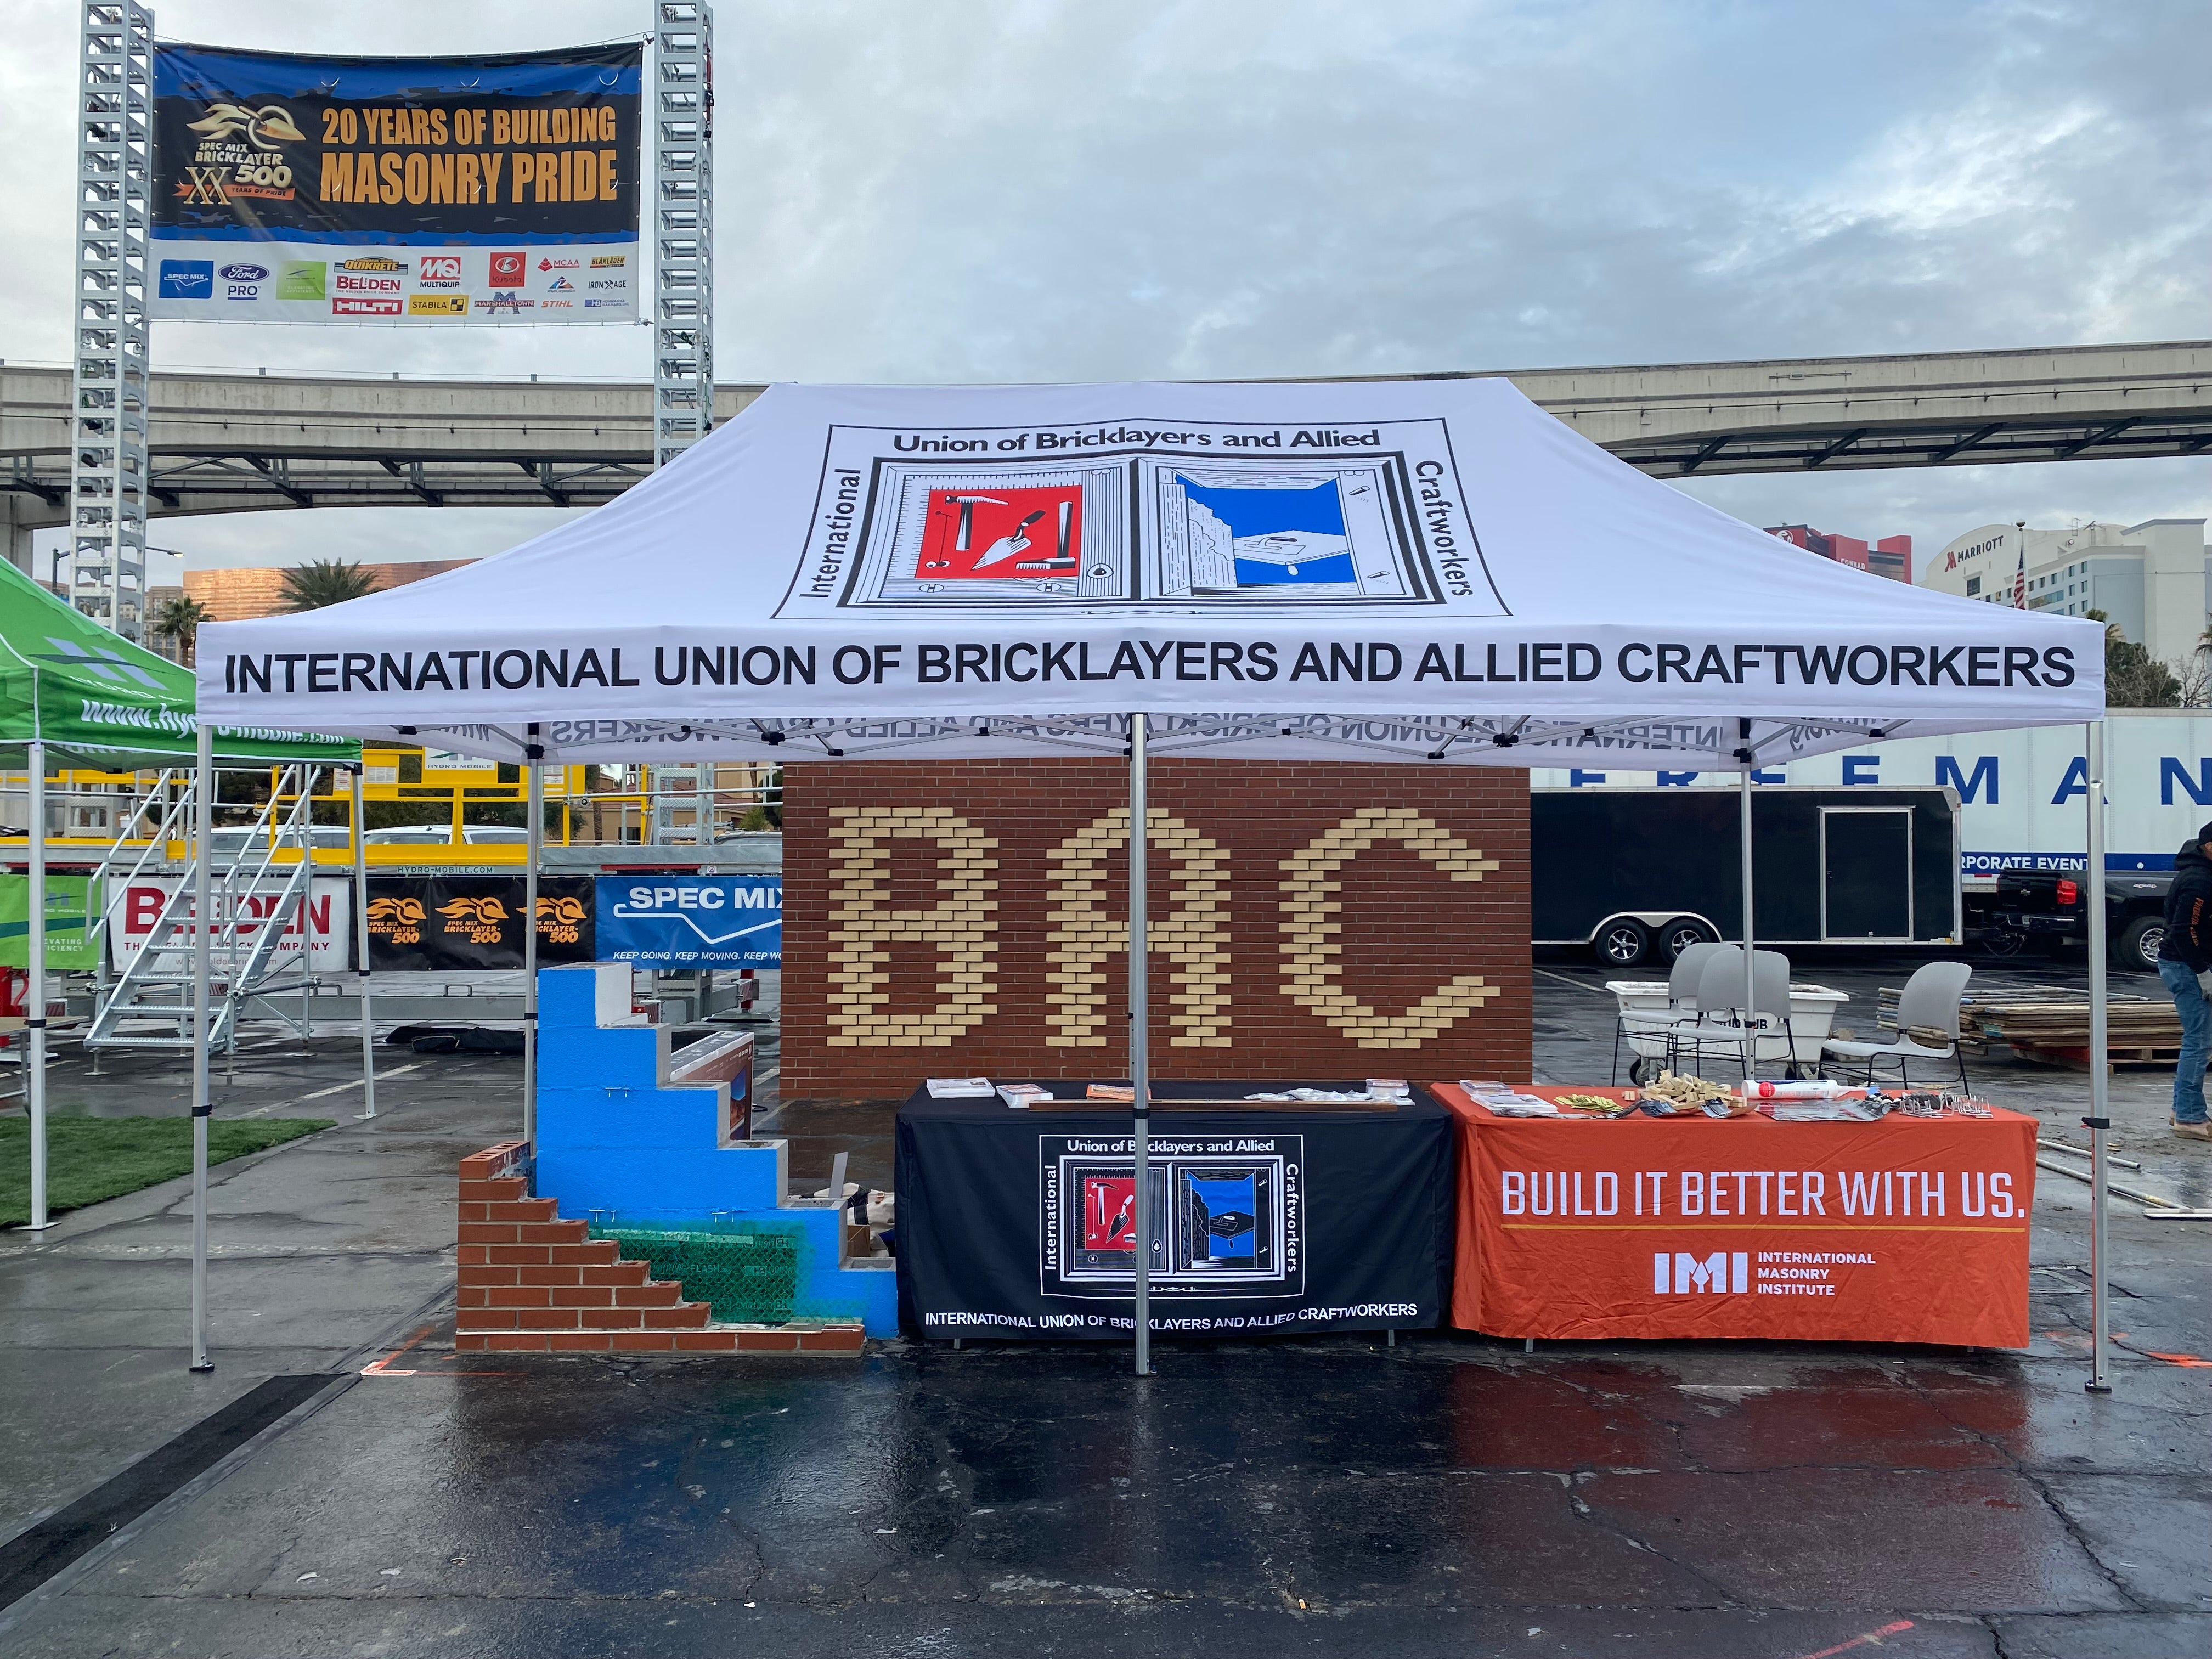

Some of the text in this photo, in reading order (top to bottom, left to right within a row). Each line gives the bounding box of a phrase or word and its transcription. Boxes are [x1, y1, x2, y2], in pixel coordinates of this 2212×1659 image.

[322, 106, 616, 145] 20 YEARS OF BUILDING
[199, 142, 248, 152] SPEC MIX
[195, 151, 283, 165] BRICKLAYER
[234, 165, 292, 188] 500
[320, 149, 617, 204] MASONRY PRIDE
[183, 167, 232, 205] XX
[228, 266, 259, 279] Ford
[345, 259, 398, 270] QUIKRETE
[228, 286, 257, 295] PRO
[336, 276, 400, 290] BELDEN
[336, 301, 398, 312] HILTI
[894, 427, 1380, 451] Union of Bricklayers and Allied
[799, 469, 860, 597] International
[1416, 461, 1472, 595] Craftworkers
[1957, 535, 2004, 562] MARRIOTT
[226, 641, 2074, 693] INTERNATIONAL UNION OF BRICKLAYERS AND ALLIED CRAFTWORKERS
[1962, 856, 2088, 870] RPORATE EVENT
[630, 887, 782, 909] SPEC MI
[828, 807, 1500, 1048] BAC
[391, 932, 420, 944] 500
[470, 932, 501, 943] 500
[549, 932, 579, 943] 500
[613, 951, 639, 960] KEEP
[641, 951, 673, 960] GOING.
[701, 952, 741, 960] MOVING.
[1067, 1139, 1274, 1154] Union of Bcklayers and Allied
[1502, 1171, 2025, 1218] BUILD IT BETTER WITH US.
[1045, 1165, 1057, 1271] International
[1286, 1164, 1300, 1272] Craftworkers
[1758, 1252, 1876, 1265] INTERNATIONAL
[1655, 1252, 1748, 1294] IMI
[1758, 1268, 1830, 1280] MASONRY
[1758, 1284, 1835, 1296] INSTITUTE
[926, 1304, 1417, 1330] INTERNATIONAL UNION OF BRIKLAYERS AND ALLIED CRAFTWORKERS
